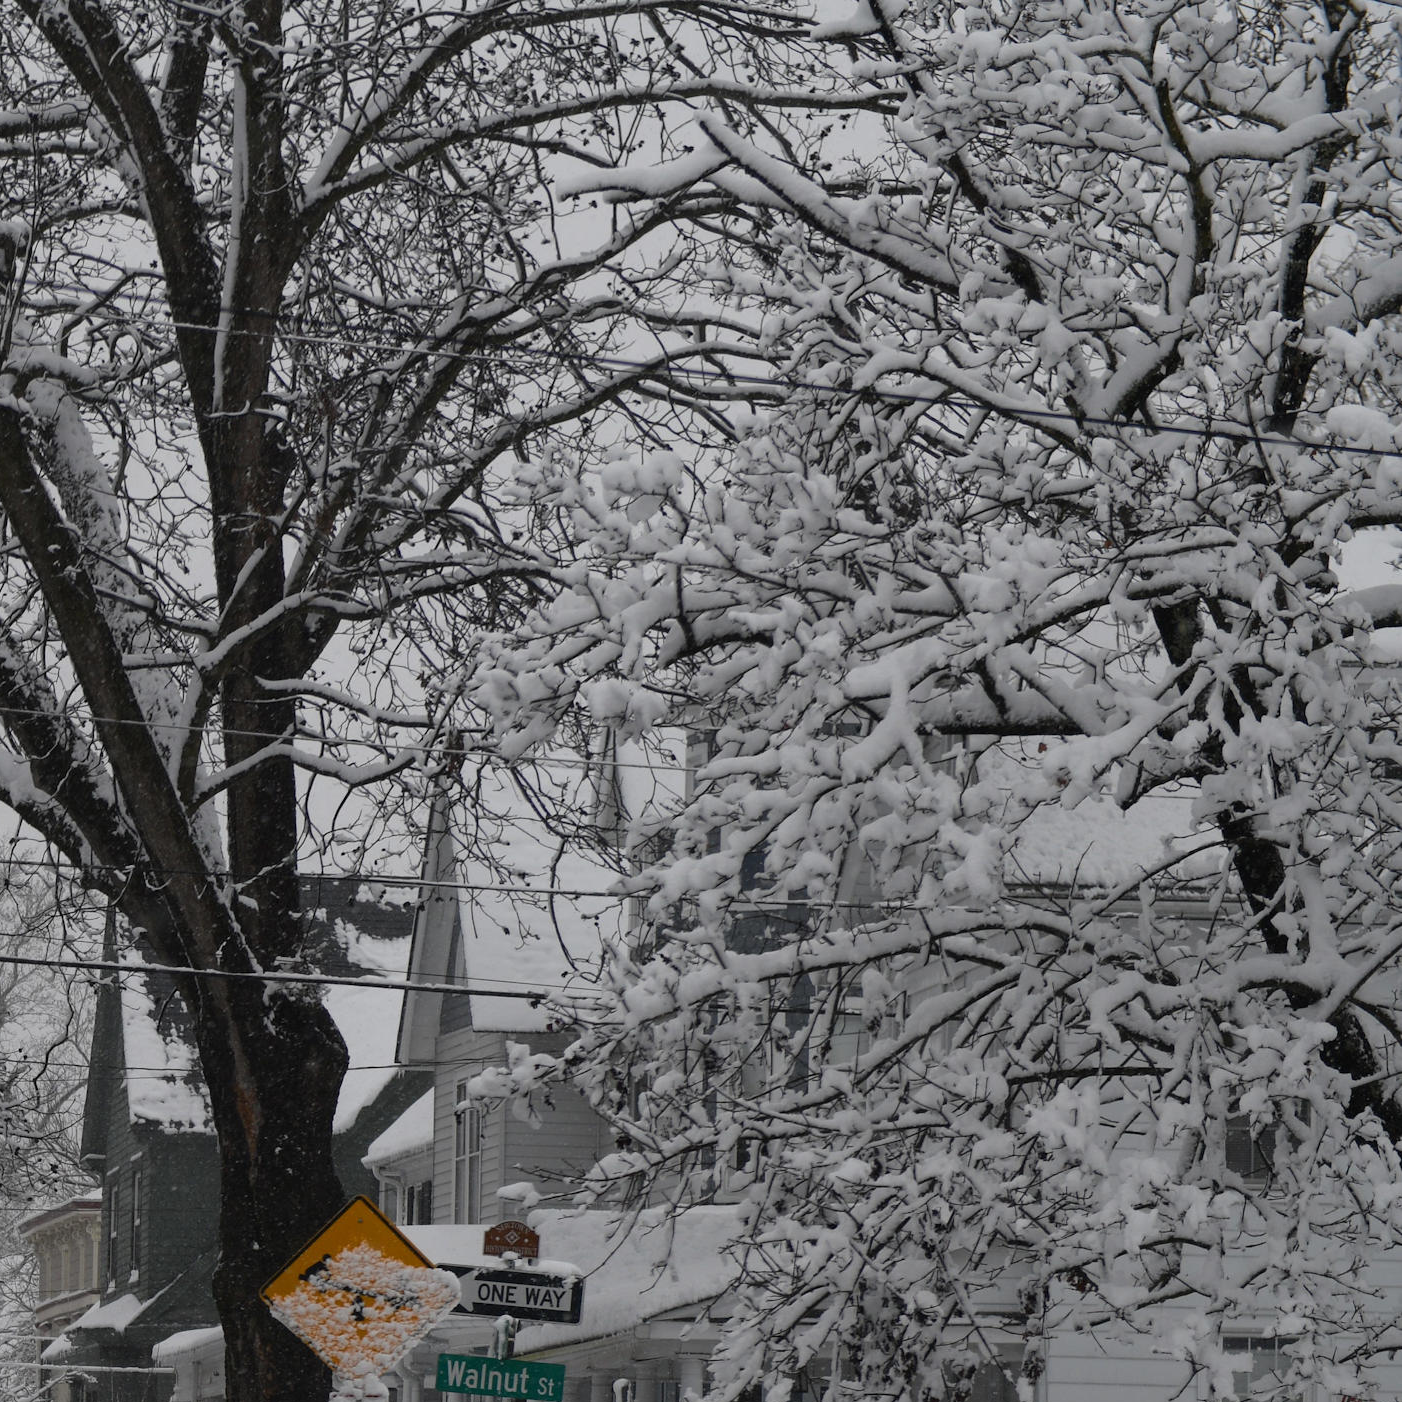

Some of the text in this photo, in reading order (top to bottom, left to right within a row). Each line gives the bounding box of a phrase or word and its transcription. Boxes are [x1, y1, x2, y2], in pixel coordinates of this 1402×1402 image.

[478, 1283, 566, 1308] ONE WAY
[447, 1360, 555, 1397] Walnut St
